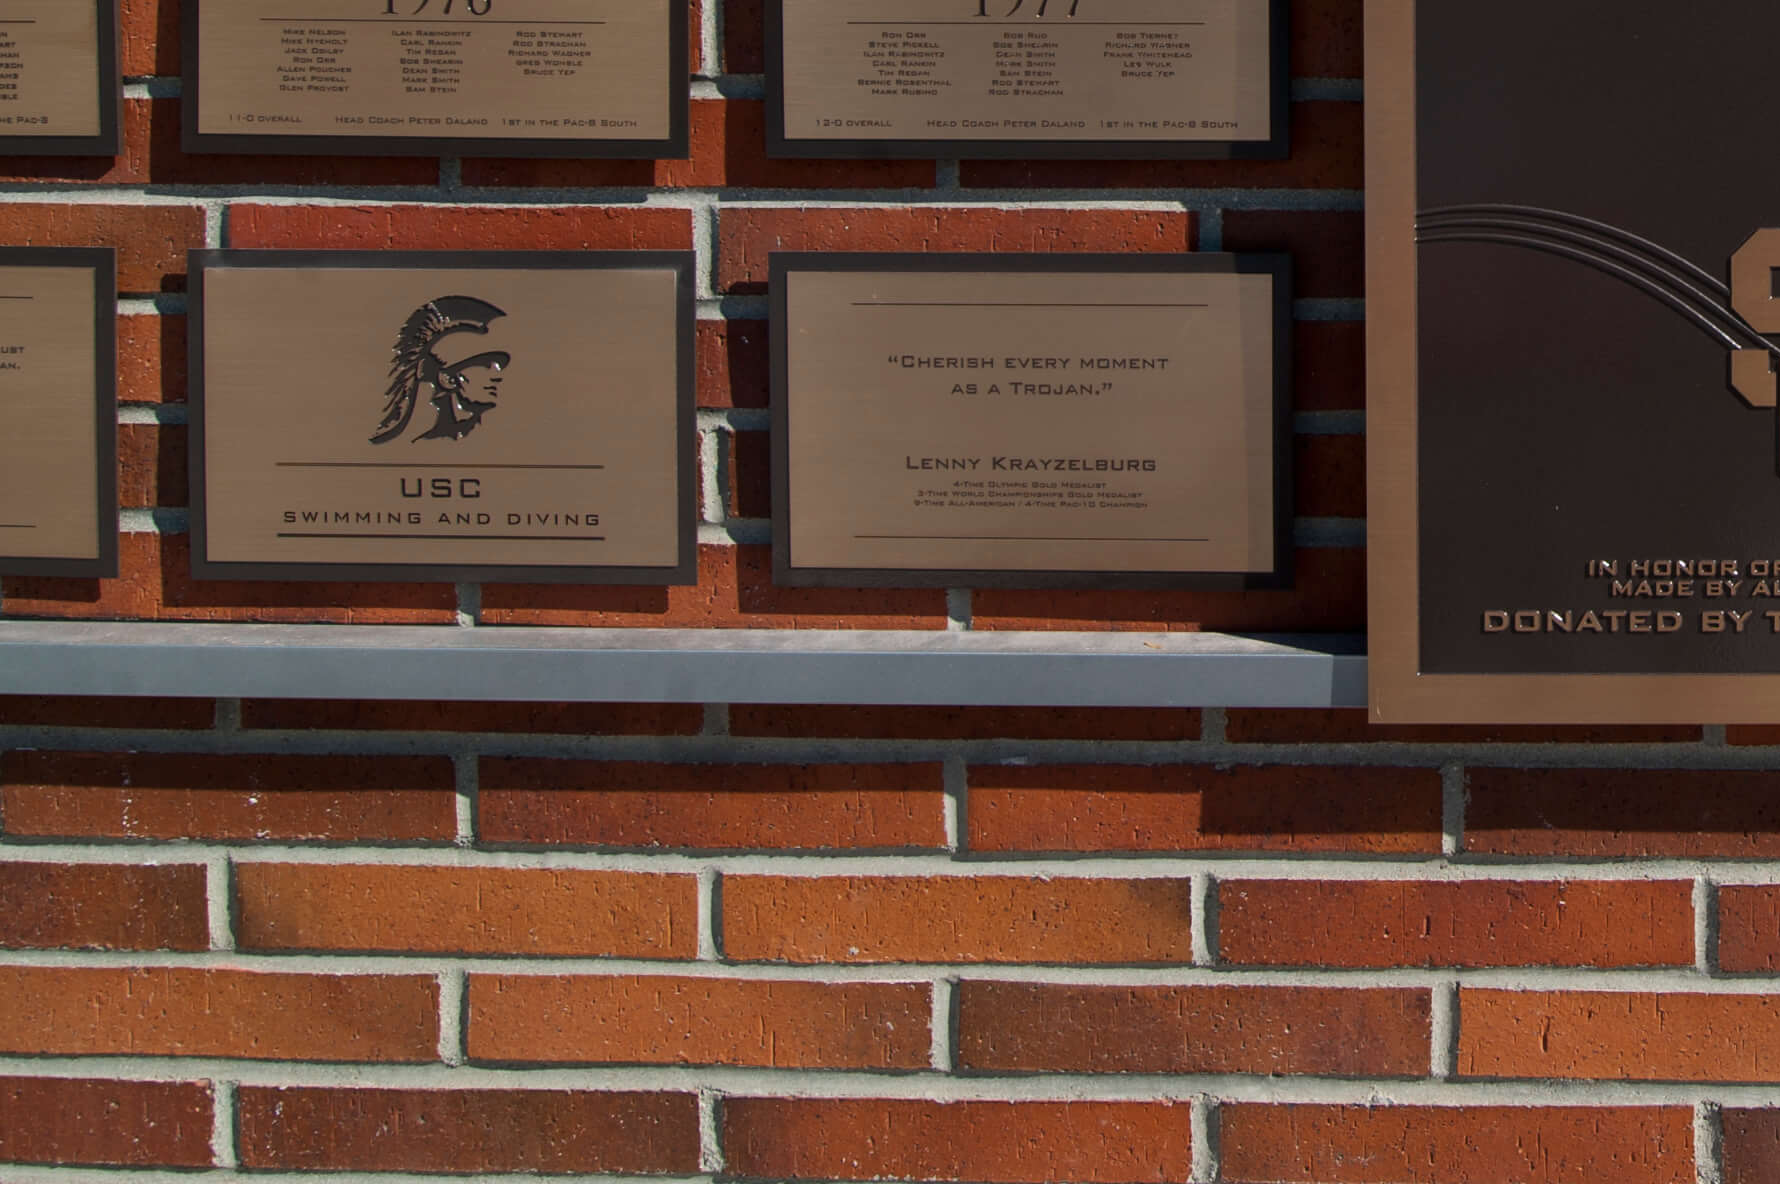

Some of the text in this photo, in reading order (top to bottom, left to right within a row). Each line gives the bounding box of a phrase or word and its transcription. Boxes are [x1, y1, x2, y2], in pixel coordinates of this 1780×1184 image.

[1004, 357, 1071, 369] EVERY
[1079, 357, 1169, 370] MOMENT
[951, 383, 978, 395] AS
[987, 383, 1001, 395] A
[906, 455, 1157, 473] LENNY KRAYZELBURG
[399, 477, 481, 499] USC
[283, 511, 600, 527] SWIMMING AND DIVING
[1587, 558, 1617, 578] IN
[1631, 558, 1739, 578] HONOR
[1610, 579, 1695, 598] MADE
[1707, 579, 1744, 598] BY
[1484, 609, 1683, 633] DONATED
[1700, 609, 1751, 633] BY
